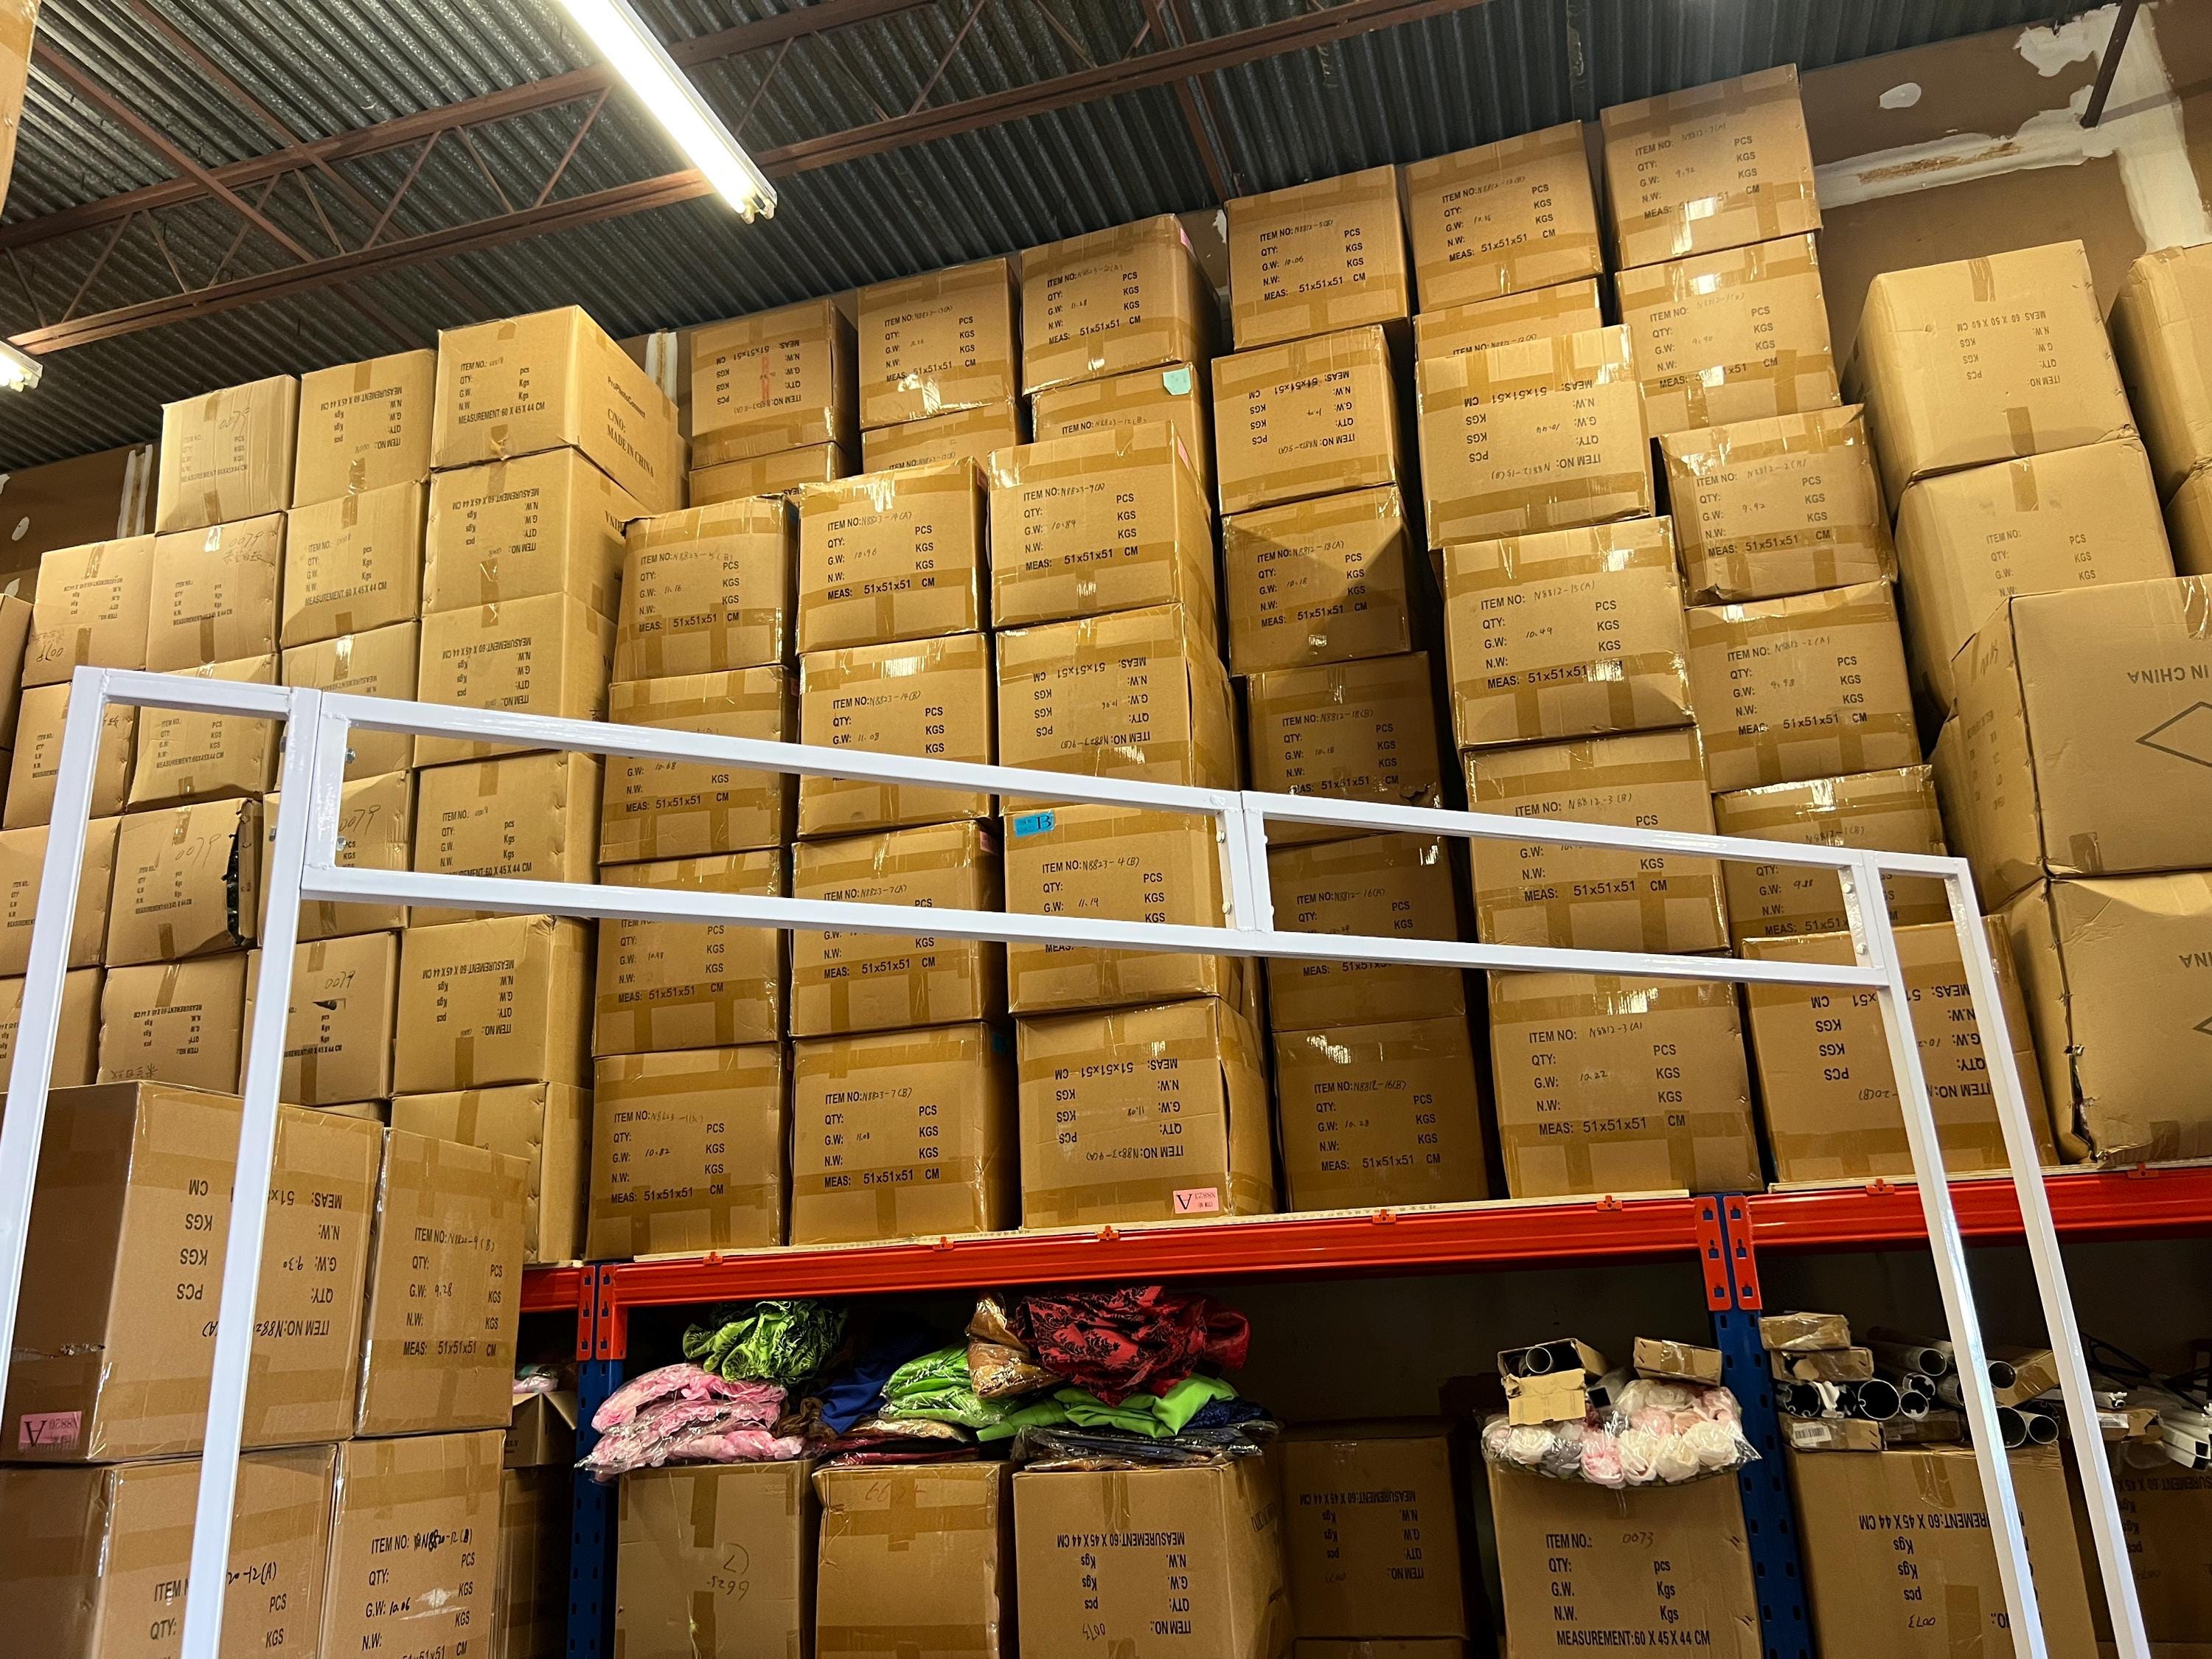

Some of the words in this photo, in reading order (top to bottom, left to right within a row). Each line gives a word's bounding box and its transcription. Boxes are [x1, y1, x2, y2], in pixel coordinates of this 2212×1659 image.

[1344, 229, 1360, 237] PCS
[1262, 261, 1279, 271] G.W:
[1346, 243, 1363, 252] KGS
[1265, 289, 1288, 301] MEAS:
[1299, 276, 1343, 292] 51x51x51
[1353, 273, 1366, 282] CM
[1957, 322, 1968, 332] CM
[1966, 370, 1982, 380] PCS
[608, 408, 626, 433] C/NO:
[608, 425, 626, 451] MADE
[627, 443, 633, 457] IN
[635, 451, 653, 478] CHINA
[1024, 490, 1043, 501] ITEM
[1045, 487, 1060, 497] NO:
[1024, 507, 1043, 518] QTY:
[1116, 493, 1134, 504] PCS
[1025, 525, 1043, 535] G.W:
[1117, 511, 1136, 521] KGS
[1025, 542, 1043, 553] N.W:
[1118, 529, 1136, 539] KGS
[1026, 559, 1051, 571] MEAS:
[1065, 549, 1113, 564] 51x51x51
[1124, 546, 1138, 556] CM
[1481, 597, 1504, 610] ITEM
[1508, 595, 1525, 605] NO:
[1483, 618, 1505, 629] QTY:
[1596, 600, 1616, 611] PCS
[1484, 637, 1507, 649] G.W:
[1597, 620, 1619, 631] KGS
[1486, 657, 1508, 669] N.W:
[1599, 641, 1621, 651] KGS
[1488, 676, 1520, 689] MEAS:
[1528, 666, 1586, 683] 51x51x51
[2127, 667, 2185, 684] CHINA
[2191, 664, 2209, 679] IN
[1037, 815, 1051, 829] B
[1529, 1032, 1554, 1043] ITEM
[1557, 1029, 1577, 1040] NO:
[1531, 1054, 1556, 1065] QTY:
[1653, 1044, 1676, 1056] PCS
[1082, 1062, 1133, 1078] 51x51x51
[1148, 1058, 1178, 1070] MEAS:
[1055, 1069, 1068, 1079] CM
[1534, 1077, 1559, 1088] G.W:
[1656, 1068, 1680, 1079] KGS
[1158, 1079, 1179, 1091] N.W:
[826, 1093, 844, 1105] ITEM
[847, 1091, 862, 1102] NO:
[1056, 1089, 1075, 1101] KGS
[1537, 1100, 1561, 1111] N.W:
[1658, 1091, 1682, 1102] KGS
[825, 1114, 844, 1124] QTY:
[919, 1105, 937, 1116] PCS
[1158, 1102, 1180, 1113] G.W:
[1057, 1110, 1076, 1122] KGS
[1160, 1123, 1181, 1135] QTY:
[1539, 1122, 1573, 1135] MEAS:
[1583, 1117, 1646, 1133] 51x51x51
[1668, 1115, 1686, 1126] CM
[825, 1134, 844, 1145] G.W:
[919, 1126, 939, 1137] KGS
[1059, 1132, 1077, 1144] PCS
[825, 1155, 843, 1166] N.W:
[919, 1147, 939, 1158] KGS
[1141, 1147, 1158, 1158] NO:
[1161, 1145, 1183, 1157] ITEM
[824, 1176, 851, 1187] MEAS:
[863, 1169, 913, 1183] 51x51x51
[925, 1168, 939, 1179] CM
[189, 1179, 208, 1196] CM
[312, 1192, 342, 1209] MEAS:
[1176, 1194, 1192, 1209] A
[185, 1214, 213, 1231] KGS
[319, 1225, 340, 1240] N.W:
[414, 1227, 432, 1242] ITEM
[434, 1229, 447, 1243] NO:
[180, 1248, 208, 1266] KGS
[315, 1256, 337, 1272] G.W:
[413, 1256, 429, 1270] QTY:
[490, 1265, 502, 1277] PCS
[177, 1284, 204, 1300] PCS
[311, 1288, 333, 1304] QTY:
[410, 1284, 426, 1298] G.W:
[435, 1282, 453, 1298] 9.28
[488, 1291, 501, 1303] KGS
[284, 1321, 304, 1336] NO:
[305, 1321, 330, 1336] ITEM
[406, 1312, 423, 1326] N.W:
[485, 1318, 498, 1329] KGS
[403, 1342, 427, 1355] MEAS:
[438, 1340, 476, 1354] 51x51x51
[487, 1344, 496, 1356] CM
[372, 1537, 392, 1554] ITEM
[394, 1534, 409, 1550] NO:
[1057, 1534, 1069, 1548] CM
[1072, 1534, 1081, 1547] 44
[1084, 1534, 1088, 1547] X
[1091, 1534, 1099, 1546] 45
[1102, 1534, 1107, 1546] X
[1546, 1534, 1569, 1548] ITEM
[1622, 1532, 1653, 1549] 0073
[1081, 1553, 1096, 1568] Kgs
[1166, 1554, 1186, 1568] N.W.
[1549, 1558, 1572, 1573] QTY:
[1654, 1560, 1670, 1575] pcs
[369, 1568, 389, 1586] QTY:
[461, 1552, 475, 1568] PCS
[1082, 1575, 1097, 1590] Kgs
[1168, 1576, 1188, 1590] G.W.
[1551, 1582, 1574, 1596] G.W.
[1658, 1581, 1675, 1599] Kgs
[366, 1600, 386, 1618] G.W:
[459, 1582, 473, 1597] KGS
[1085, 1596, 1098, 1609] pcs
[1169, 1598, 1189, 1611] QTY:
[1554, 1606, 1577, 1621] N.W.
[1660, 1605, 1679, 1624] Kgs
[362, 1632, 382, 1651] N.W:
[456, 1611, 470, 1627] KGS
[1170, 1621, 1191, 1634] ITEM
[1649, 1630, 1656, 1645] X
[1658, 1630, 1669, 1645] 45
[1671, 1630, 1678, 1646] X
[1680, 1630, 1691, 1645] 44
[1694, 1630, 1711, 1645] CM
[456, 1641, 467, 1656] CM
